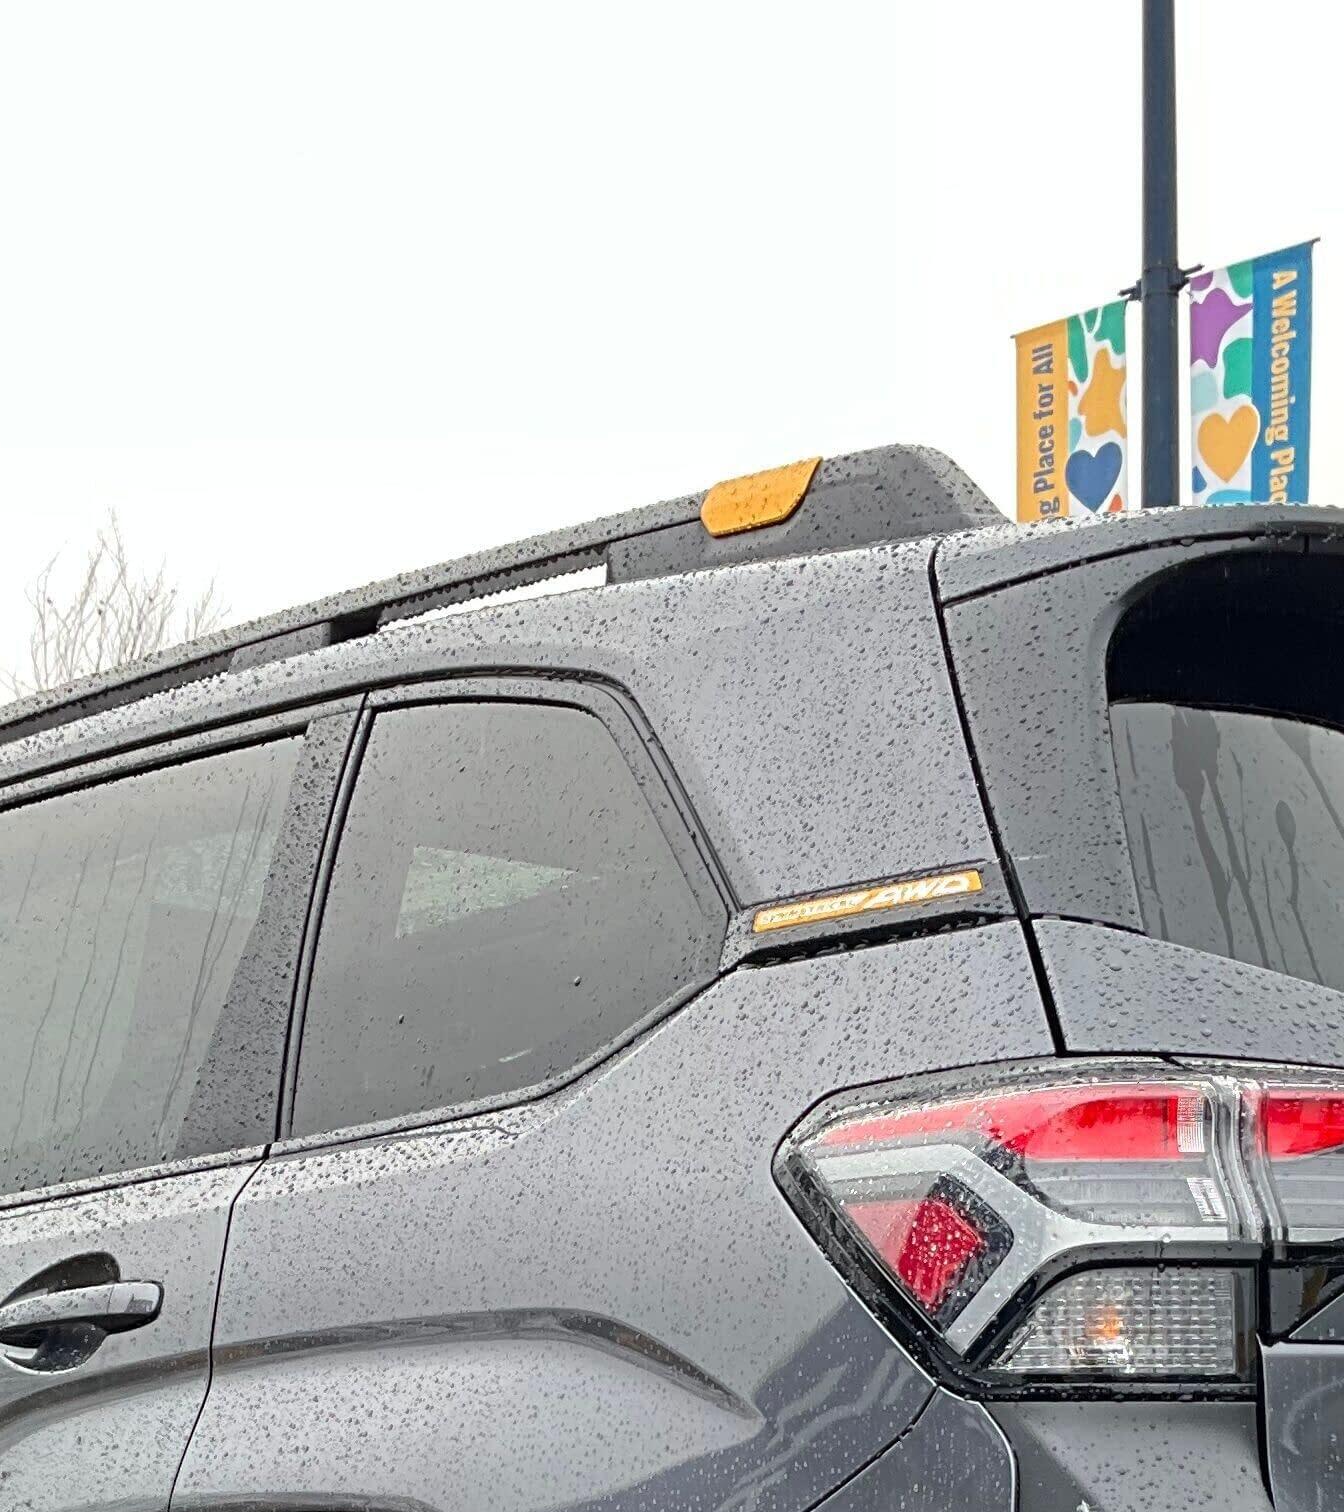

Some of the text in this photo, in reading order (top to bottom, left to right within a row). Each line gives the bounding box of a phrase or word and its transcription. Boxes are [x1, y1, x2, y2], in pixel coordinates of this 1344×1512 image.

[1032, 343, 1054, 375] All
[1033, 384, 1054, 420] for
[1265, 269, 1298, 503] A Welcoming Plac
[1033, 424, 1055, 494] Place
[859, 874, 971, 910] AWD
